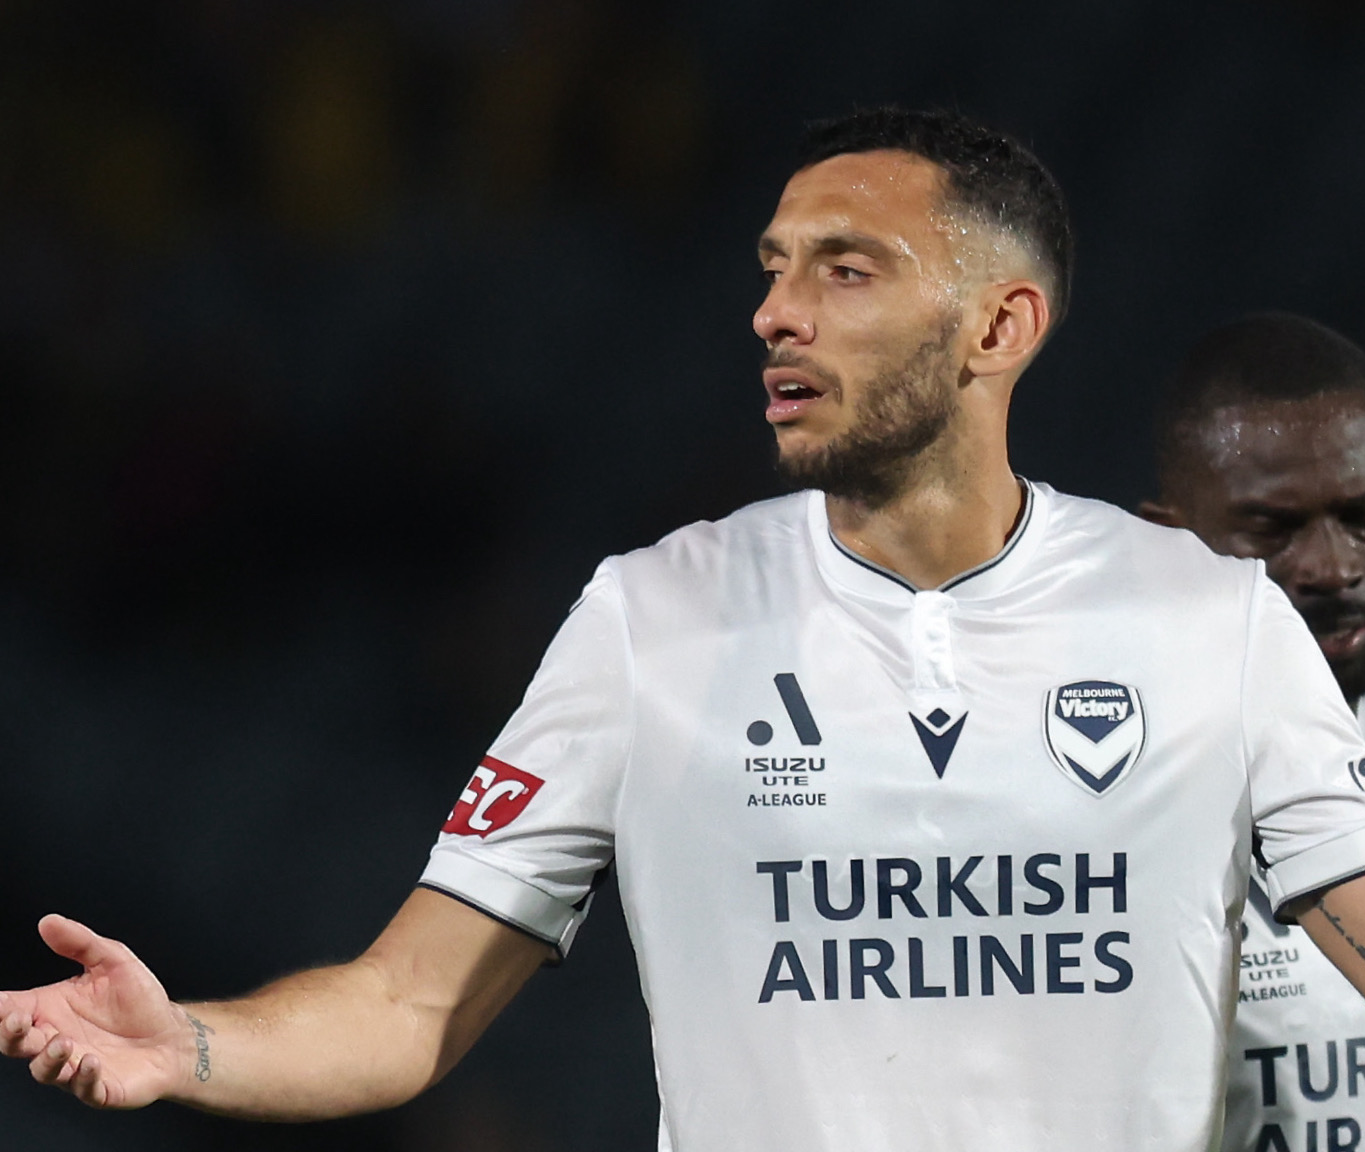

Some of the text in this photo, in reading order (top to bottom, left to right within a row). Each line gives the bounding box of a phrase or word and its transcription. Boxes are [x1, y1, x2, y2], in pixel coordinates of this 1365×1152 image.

[1062, 689, 1125, 698] MELBOURNE
[1059, 699, 1128, 720] Victory
[745, 758, 825, 772] ISUZU
[762, 776, 809, 786] UTE
[447, 765, 526, 831] FC
[756, 852, 1127, 922] TURKISH
[757, 930, 1134, 1004] AIRLINES
[1240, 948, 1299, 969] SUZU
[1249, 969, 1290, 981] UTE
